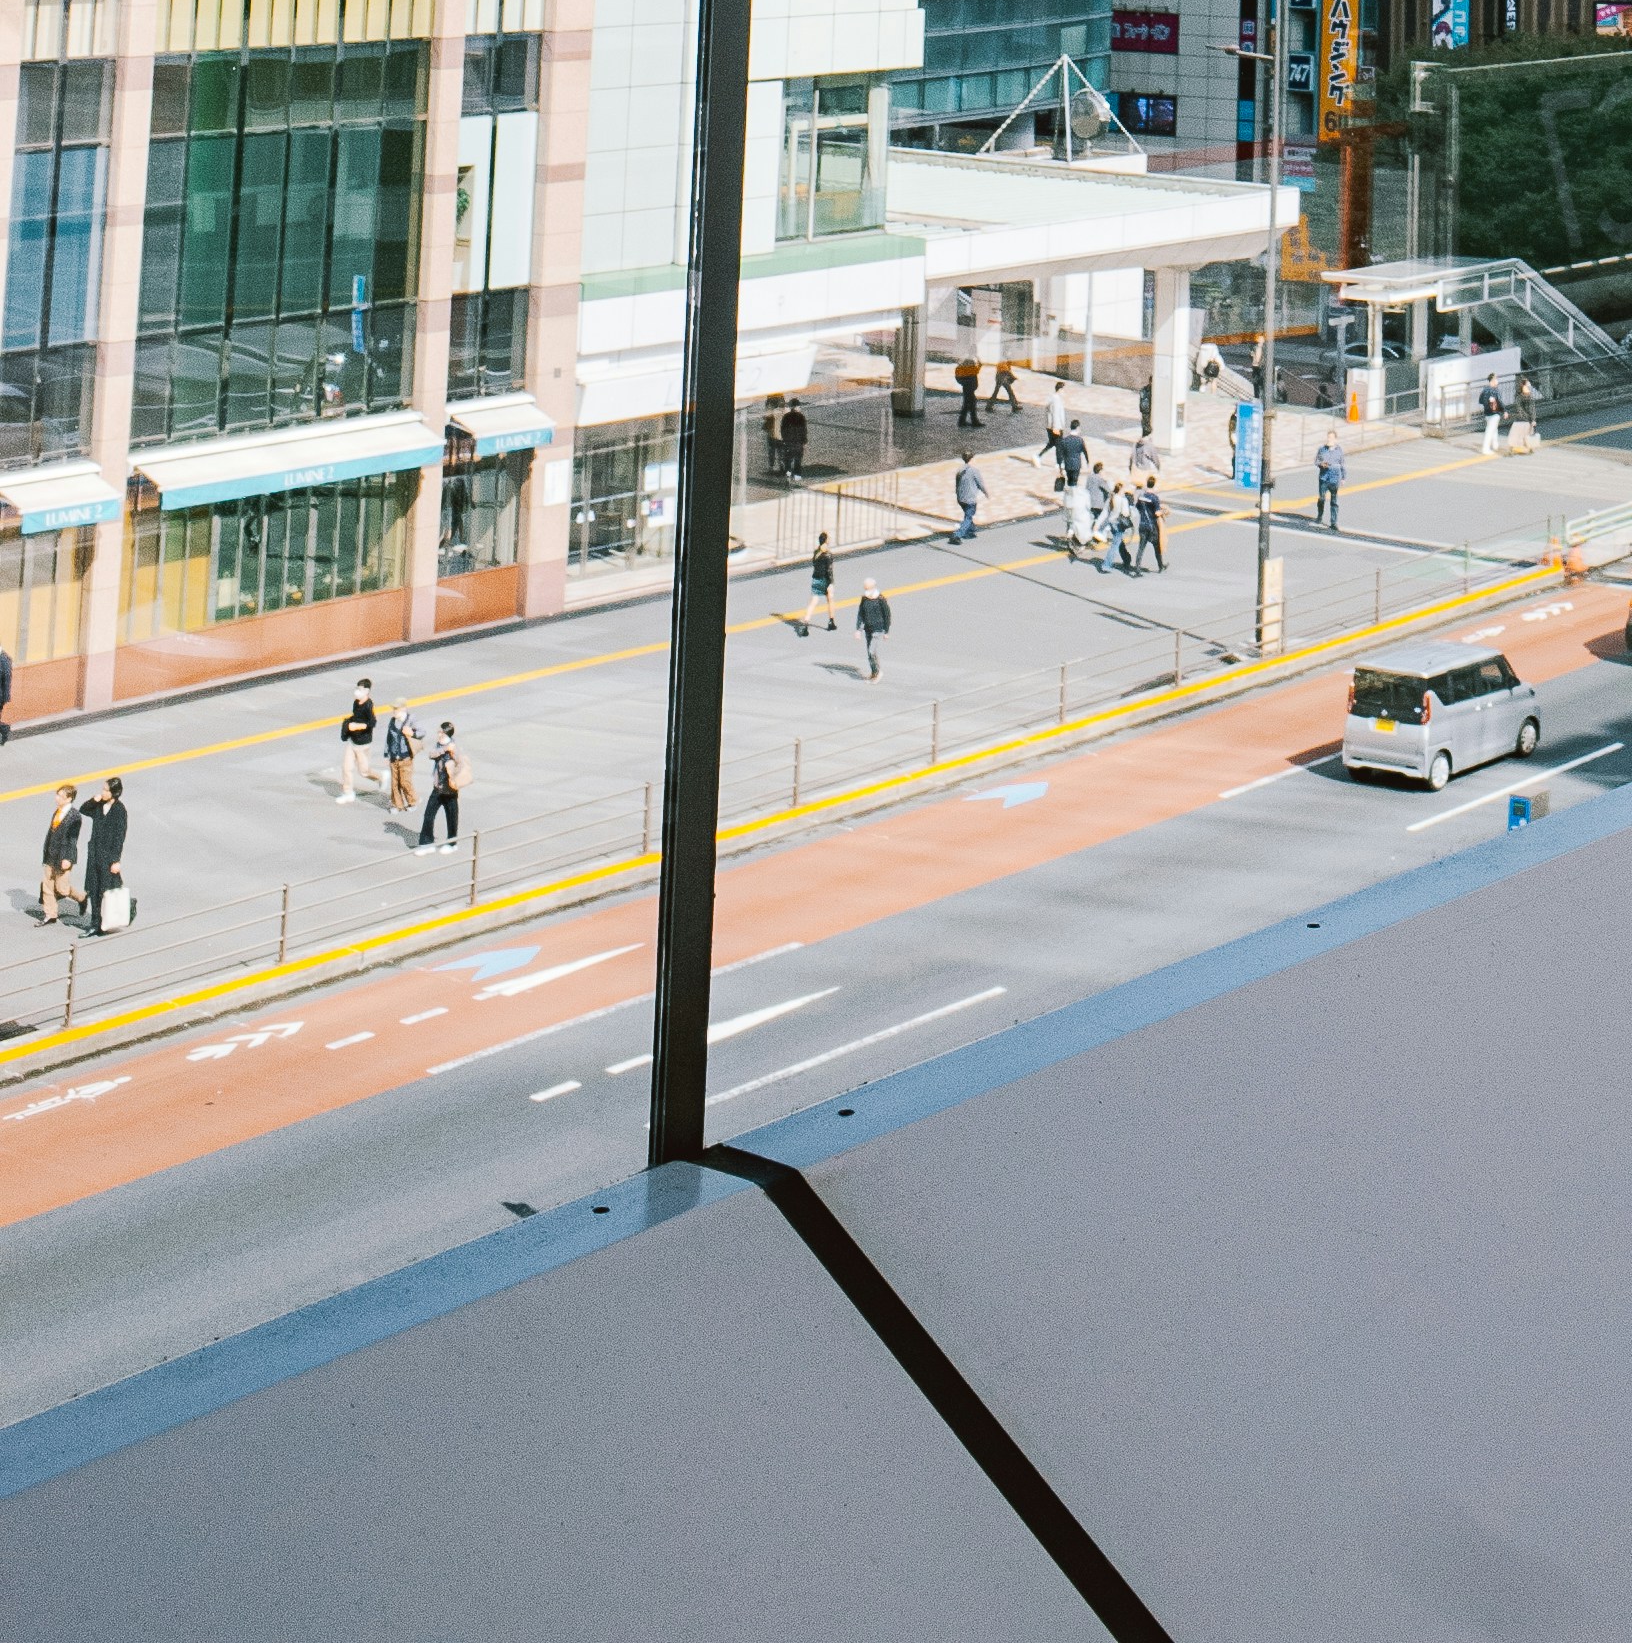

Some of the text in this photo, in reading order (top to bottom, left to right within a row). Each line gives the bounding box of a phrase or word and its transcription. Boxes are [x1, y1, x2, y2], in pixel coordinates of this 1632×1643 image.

[1289, 63, 1310, 85] 747
[495, 435, 532, 450] LUMINE
[284, 466, 334, 486] LUMINE 2
[45, 504, 103, 526] LUMINE 2
